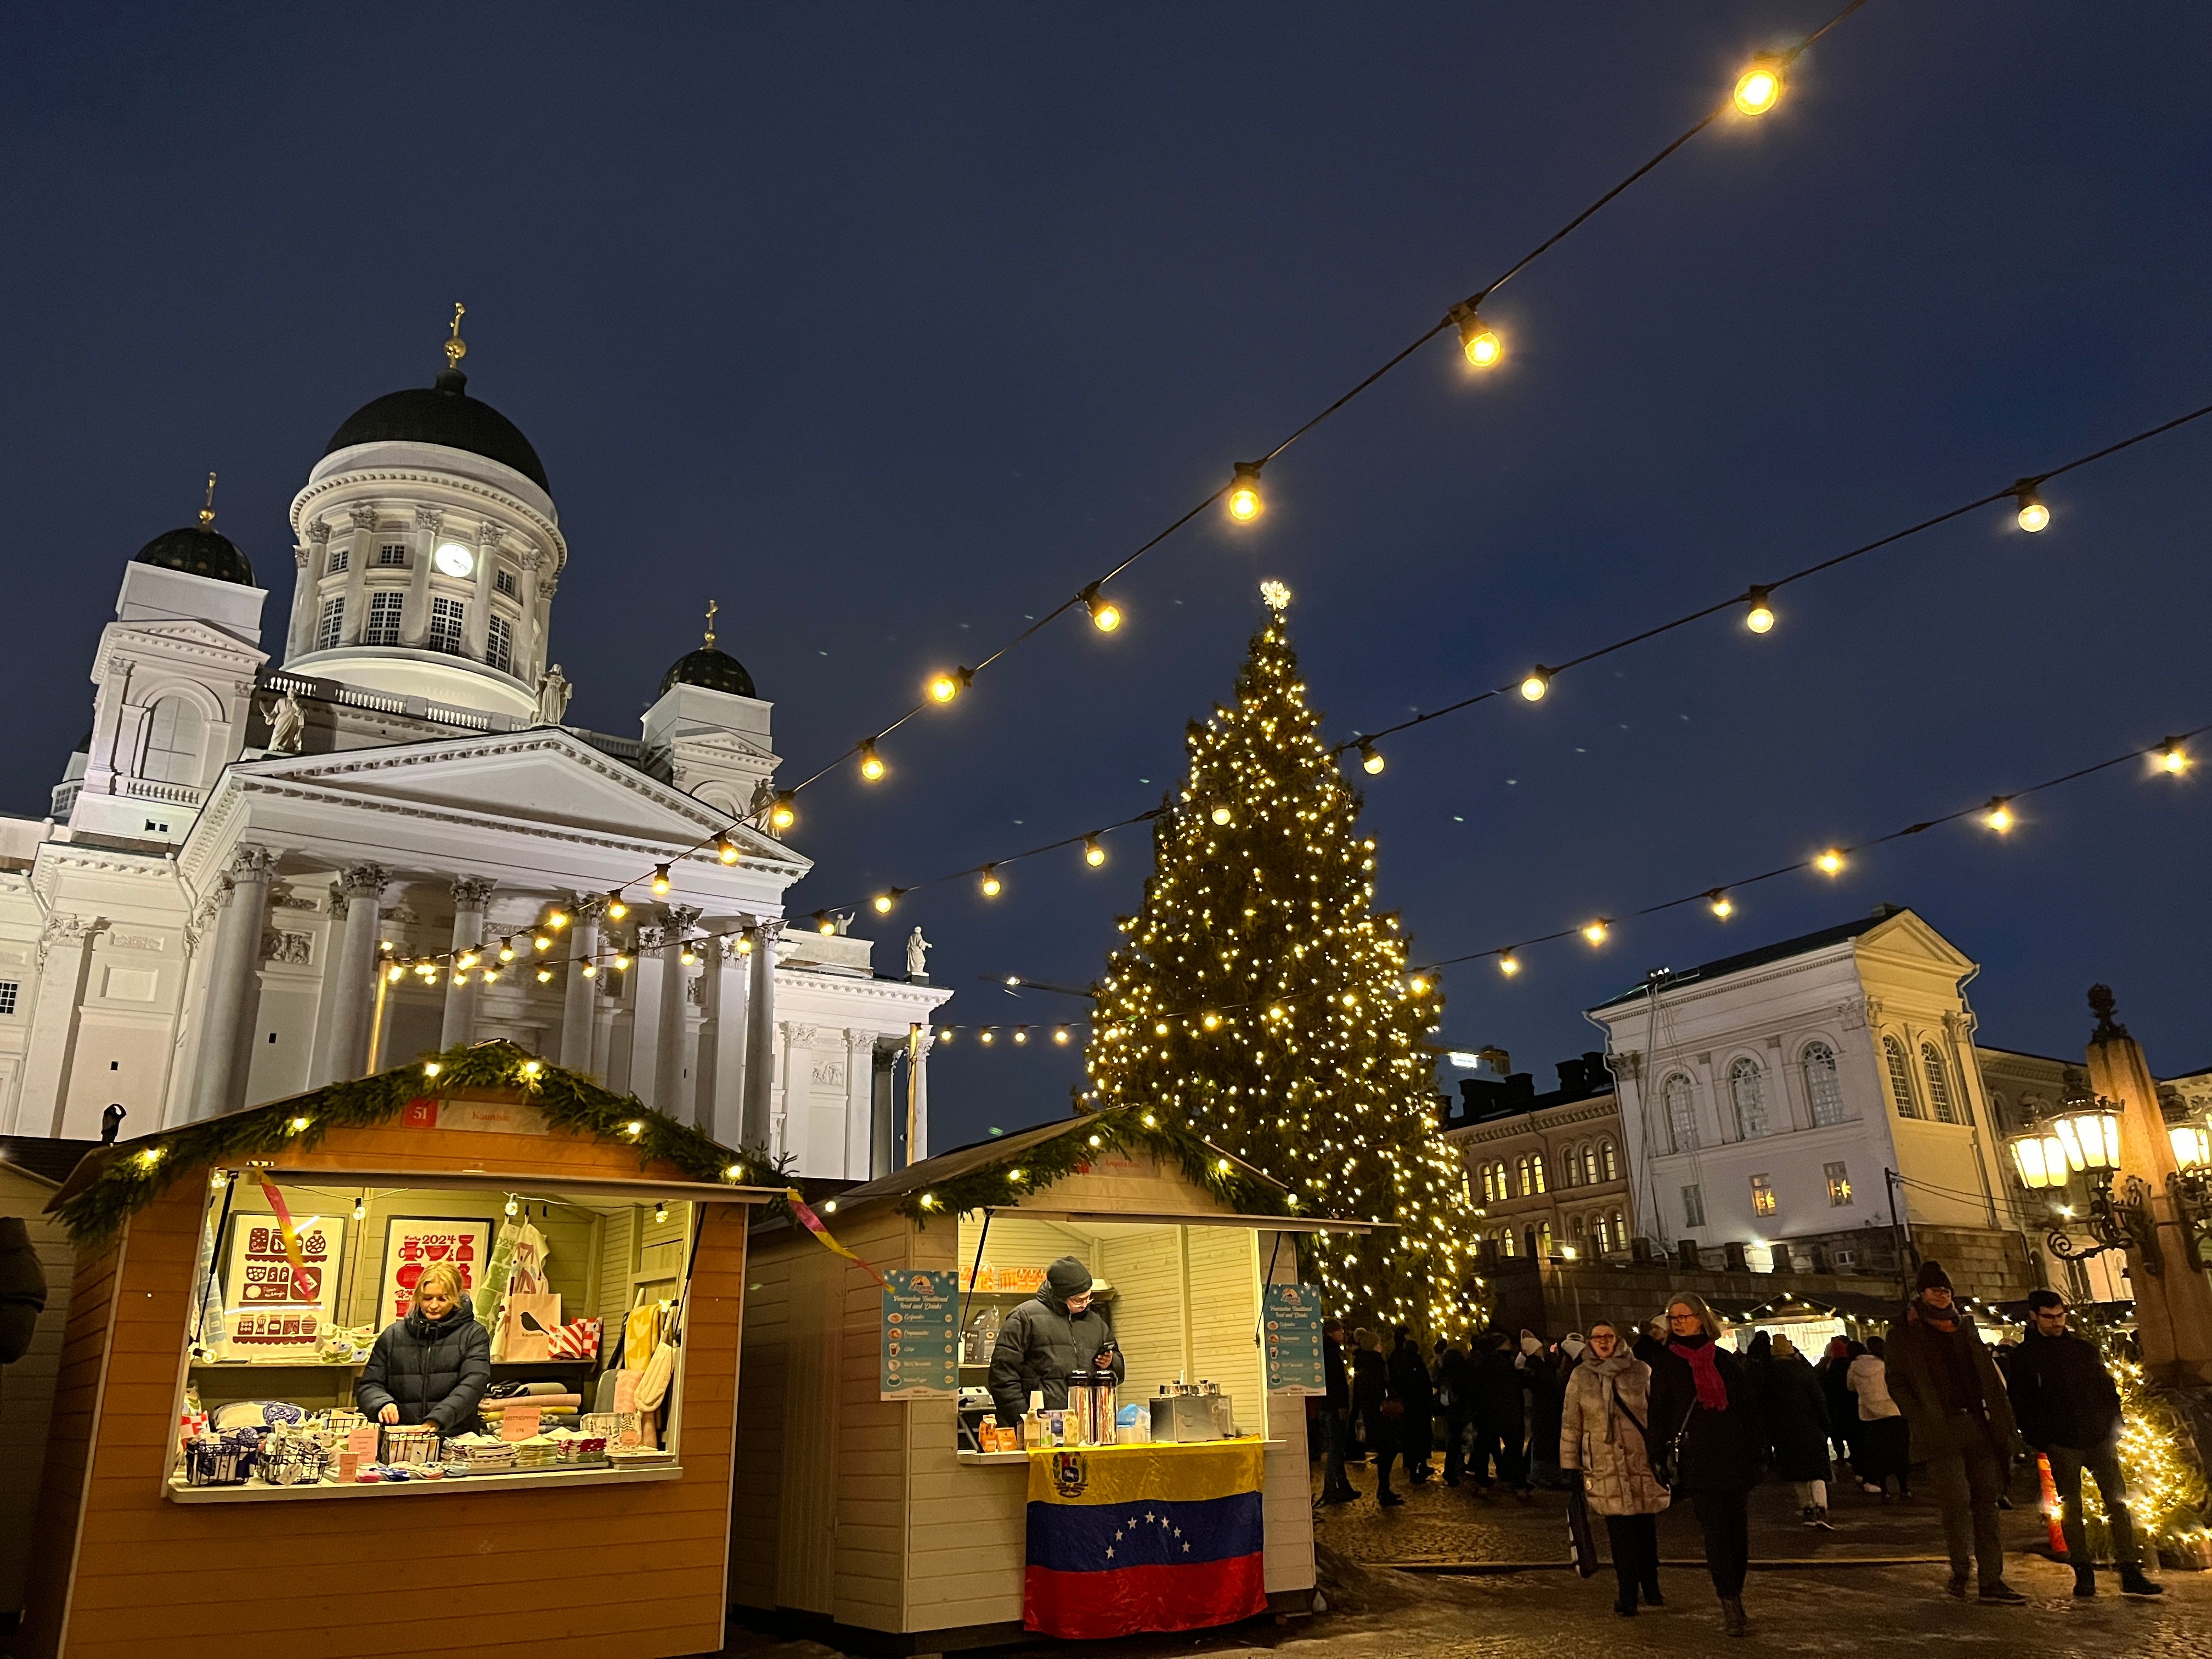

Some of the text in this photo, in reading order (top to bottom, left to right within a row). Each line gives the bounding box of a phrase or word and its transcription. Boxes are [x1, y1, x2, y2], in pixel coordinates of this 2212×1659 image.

[413, 1107, 427, 1120] 51
[472, 1111, 510, 1122] Kauniste
[422, 1234, 456, 1244] 2024
